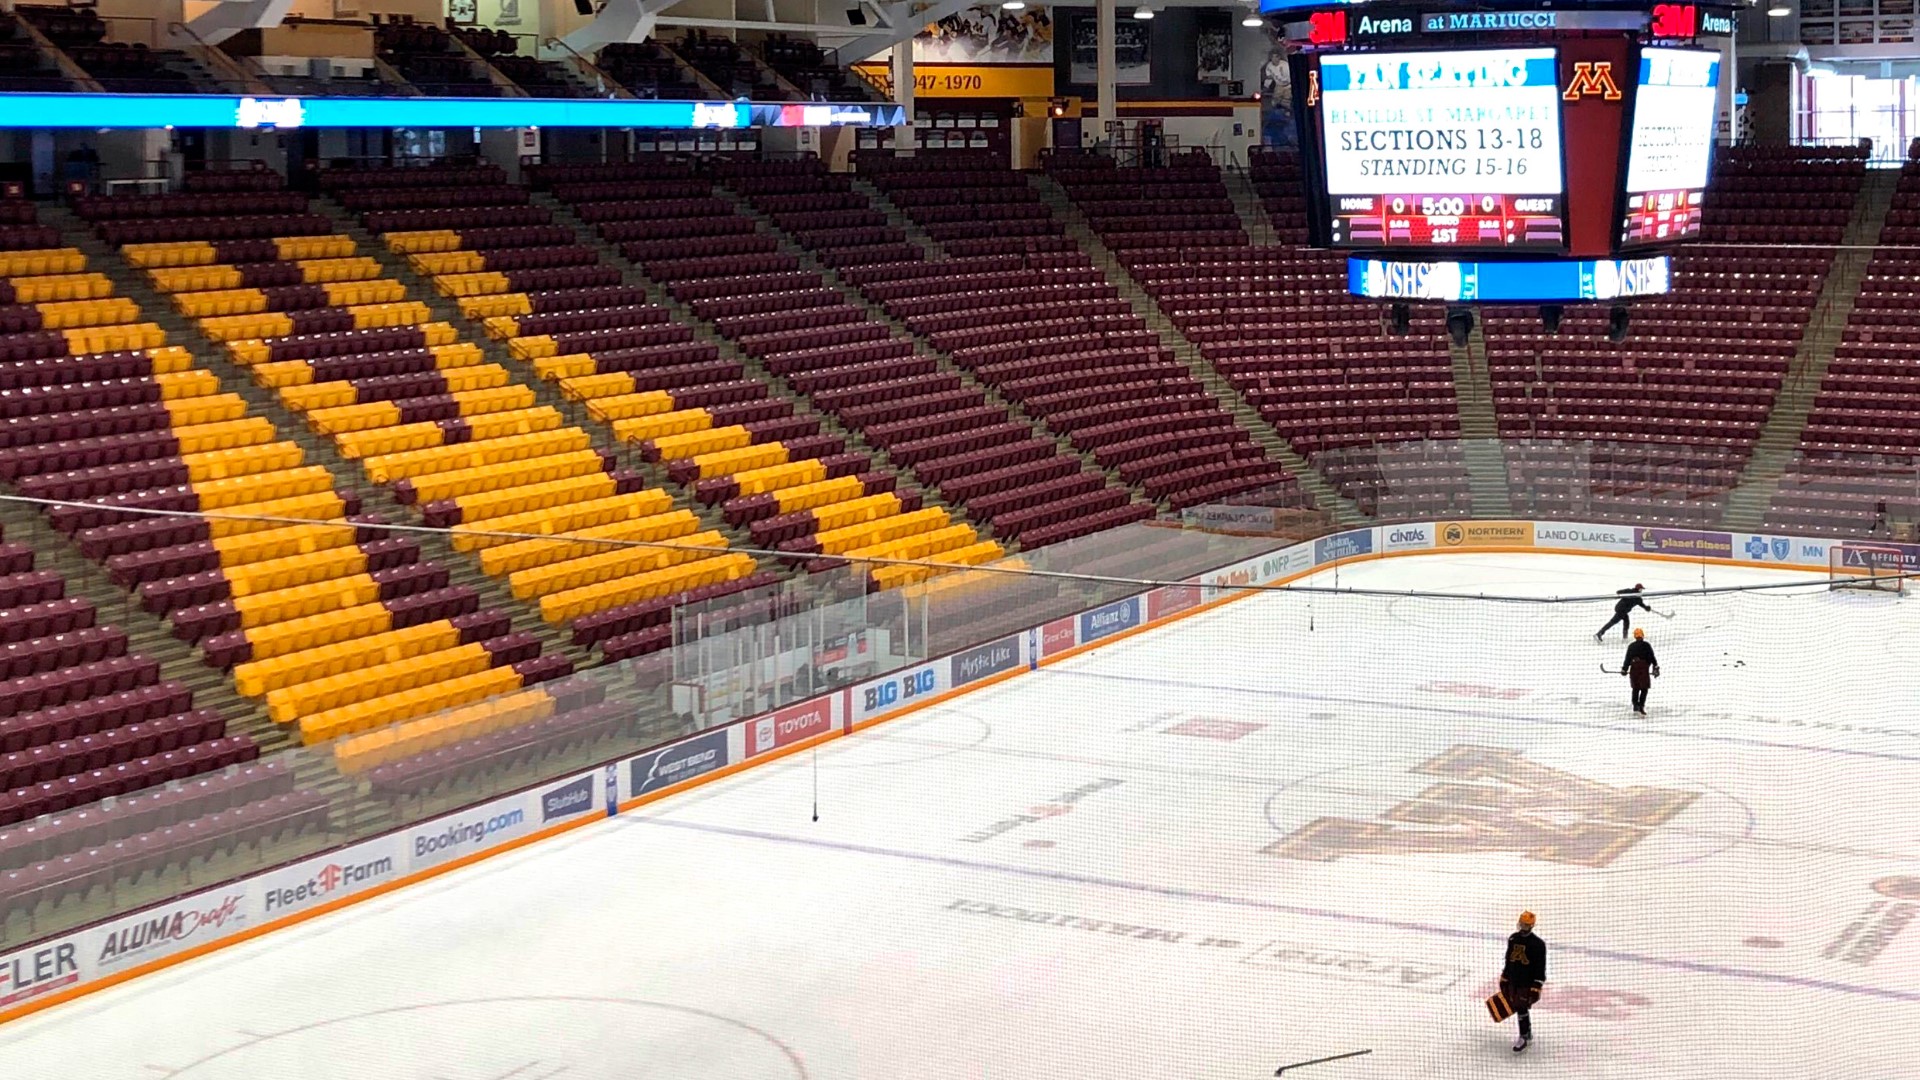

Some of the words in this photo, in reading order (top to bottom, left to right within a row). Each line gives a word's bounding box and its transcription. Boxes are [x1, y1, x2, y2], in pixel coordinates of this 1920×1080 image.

[1309, 11, 1346, 43] 3M
[1358, 16, 1412, 34] Arena
[1428, 15, 1444, 29] at
[1450, 13, 1556, 29] MARIUCCI
[1652, 5, 1695, 37] 3M
[1702, 13, 1730, 32] Arena
[913, 75, 982, 90] 47-1970
[1563, 62, 1621, 99] M
[1341, 130, 1467, 151] SECTIONS
[1478, 128, 1542, 149] 13-18
[1360, 159, 1466, 176] STANDING
[1476, 158, 1527, 175] 15-16
[1340, 198, 1373, 210] HOME
[1392, 197, 1405, 213] 0
[1422, 197, 1464, 215] 5:00
[1481, 196, 1494, 212] 0
[1515, 199, 1553, 211] GUEST
[1431, 228, 1458, 242] 1ST
[1468, 527, 1524, 536] NORTHERN
[1537, 530, 1567, 540] LAND
[1661, 538, 1694, 548] planet
[1696, 540, 1731, 550] fitness
[1803, 545, 1823, 557] MN
[1271, 555, 1290, 573] NFP
[1871, 552, 1917, 563] AFFINITY
[1091, 610, 1119, 629] Allianz
[777, 711, 822, 735] TOYOTA
[658, 760, 687, 777] WEST
[687, 749, 717, 766] BEND
[415, 808, 524, 857] Booking.com
[265, 882, 317, 912] Fleet
[343, 856, 392, 886] Farm
